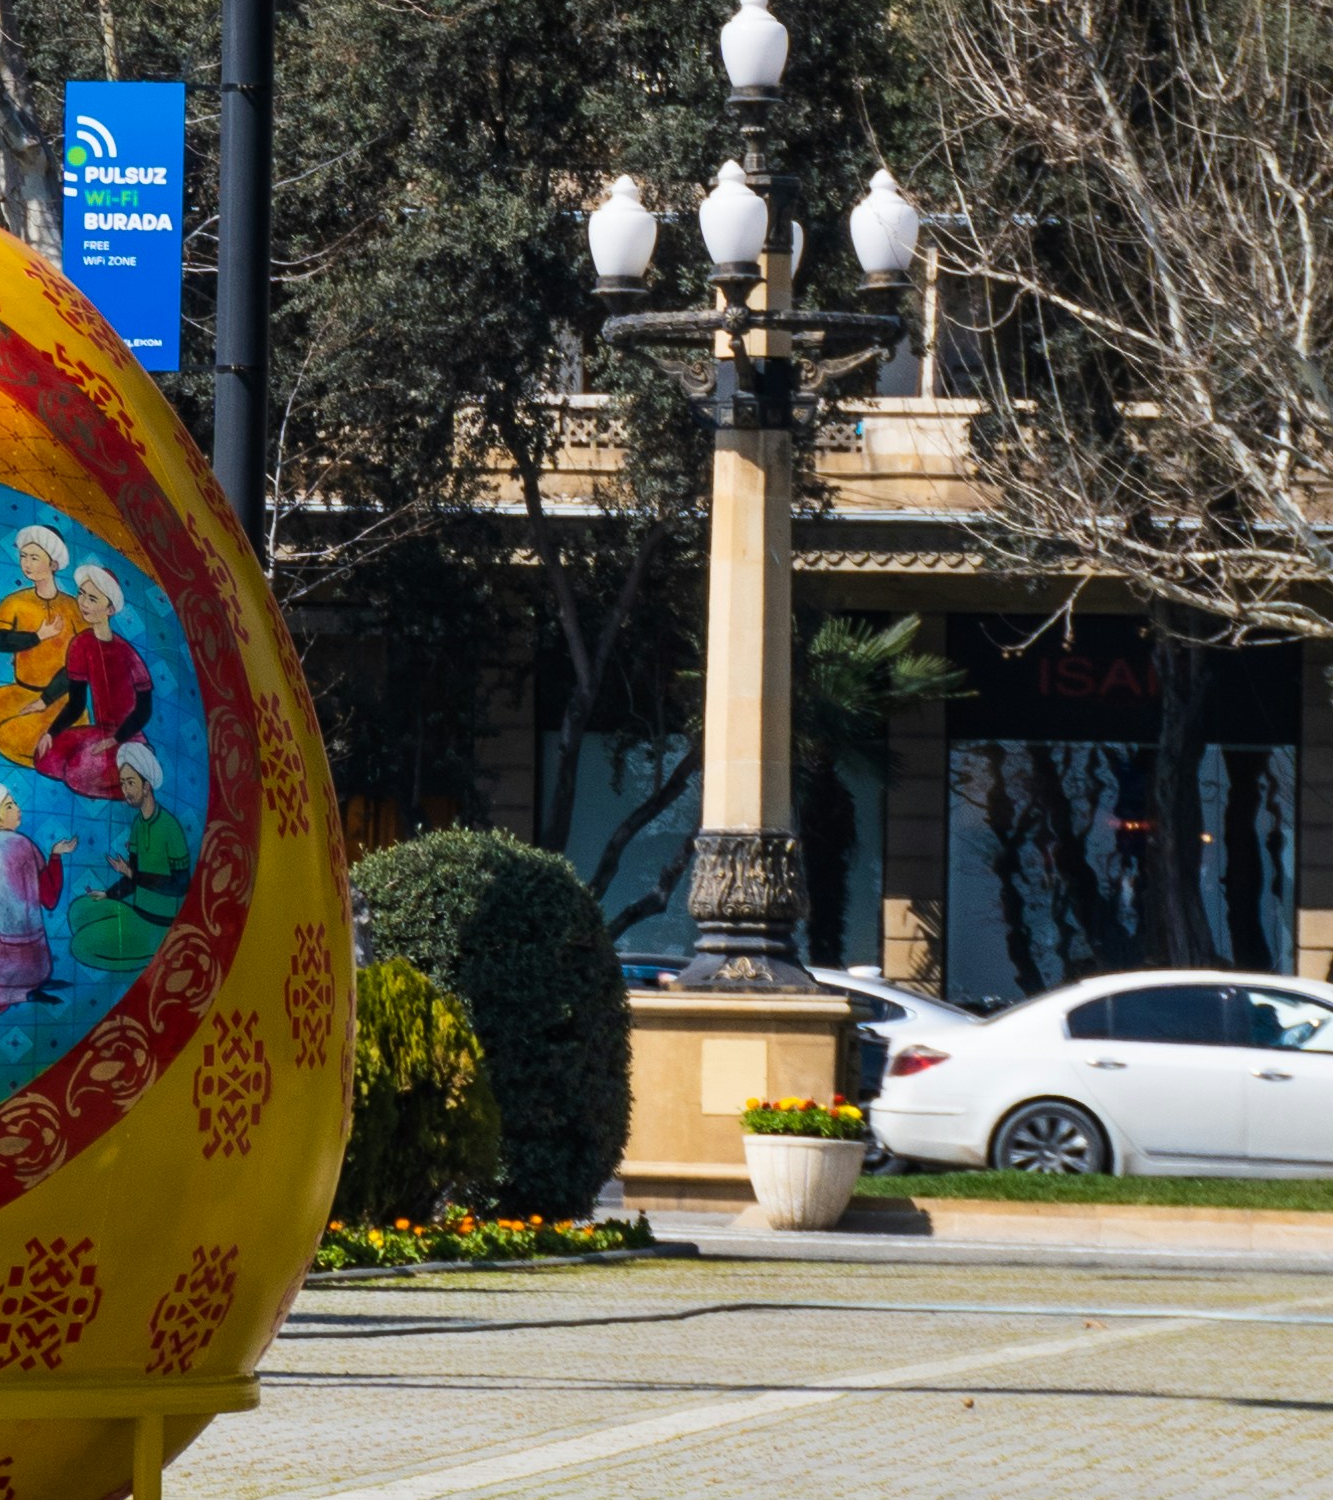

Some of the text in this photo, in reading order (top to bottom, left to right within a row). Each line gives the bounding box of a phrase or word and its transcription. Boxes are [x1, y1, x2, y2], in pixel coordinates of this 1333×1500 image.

[84, 166, 167, 185] PULSUZ
[84, 189, 138, 207] Wi-Fi
[84, 212, 173, 231] BURADA
[83, 240, 110, 251] FREE
[108, 256, 137, 267] ZONE
